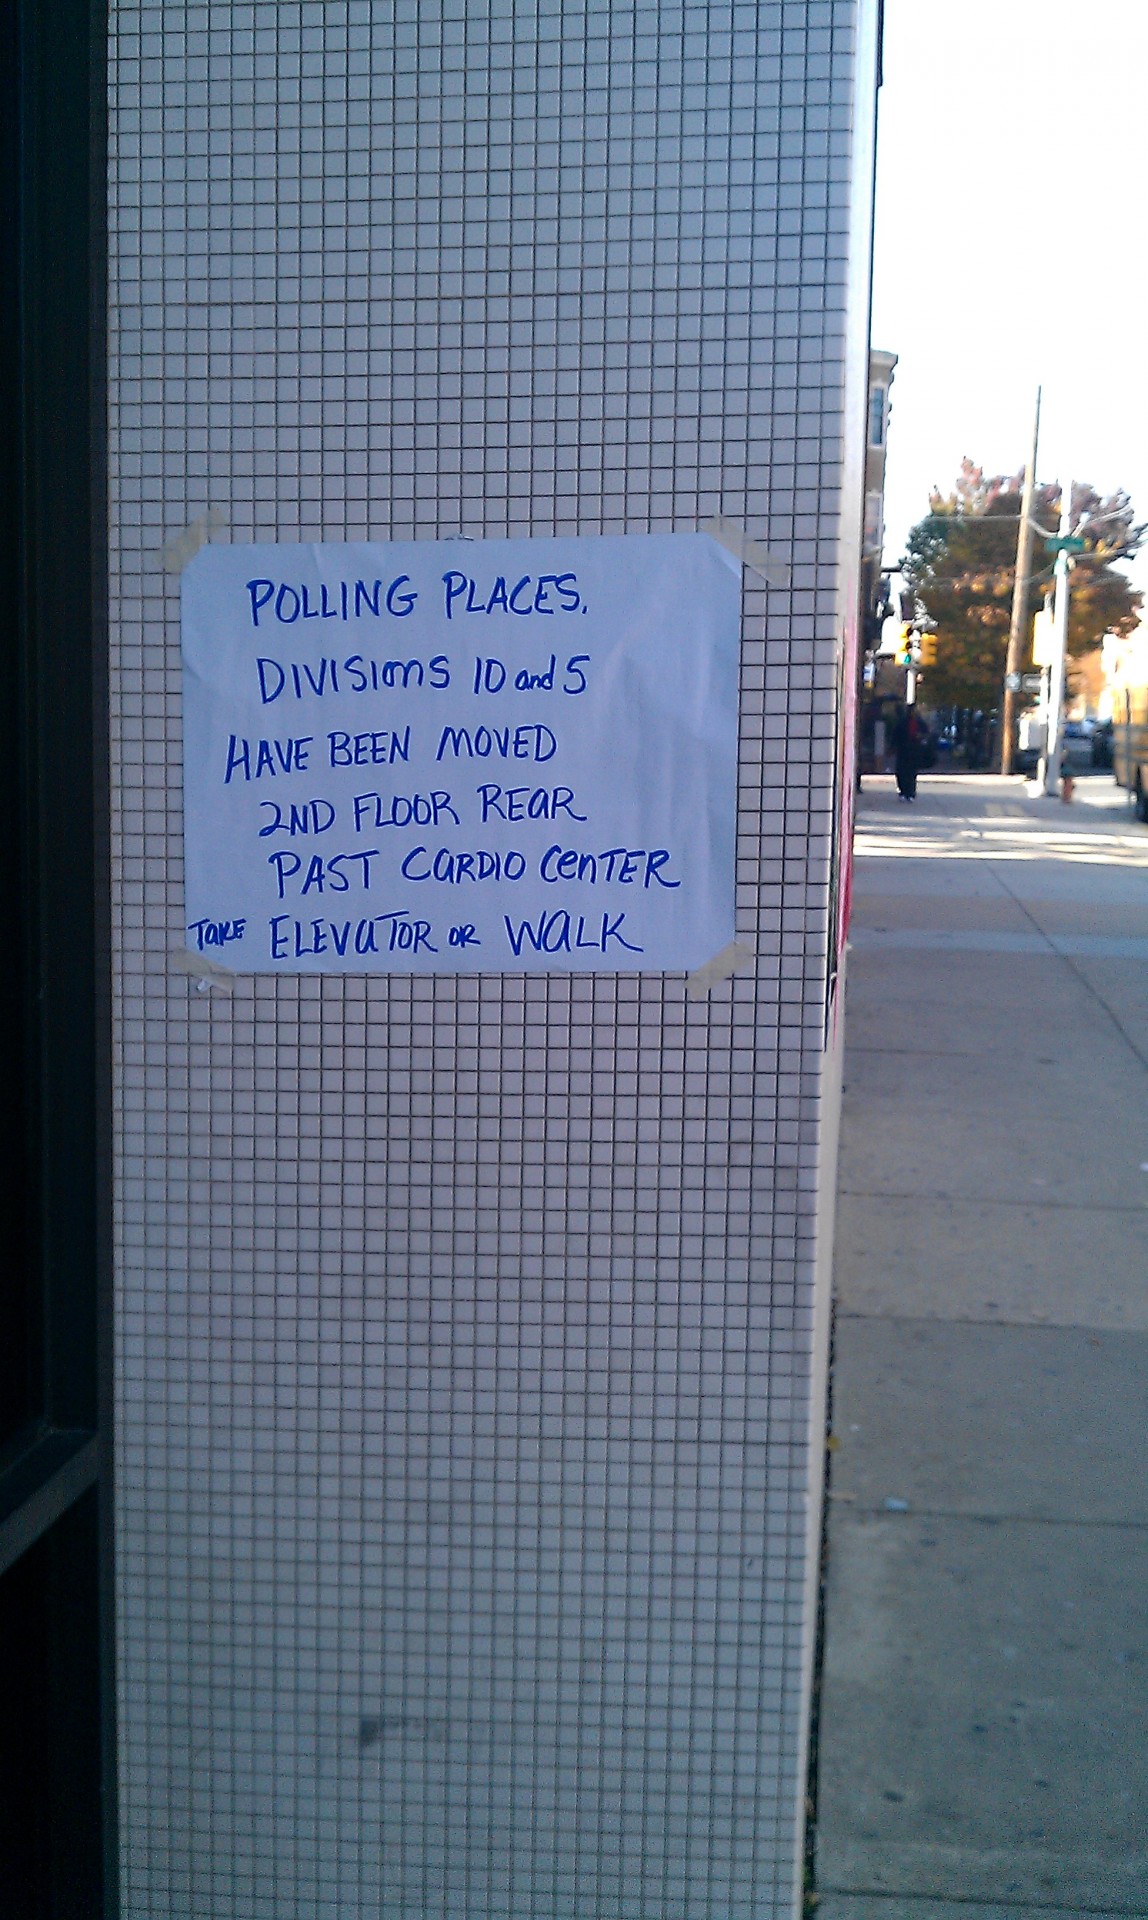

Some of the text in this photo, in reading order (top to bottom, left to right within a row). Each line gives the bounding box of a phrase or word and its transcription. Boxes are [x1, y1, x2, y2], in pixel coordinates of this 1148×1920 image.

[245, 575, 419, 627] POLLING
[473, 656, 507, 695] 10
[515, 654, 556, 691] and
[562, 654, 591, 695] 5
[223, 725, 557, 785] HAVE BEEN MOVED
[258, 799, 336, 838] 2ND
[352, 790, 461, 833] FLOOR
[267, 849, 381, 900] PAST
[448, 924, 482, 949] OR
